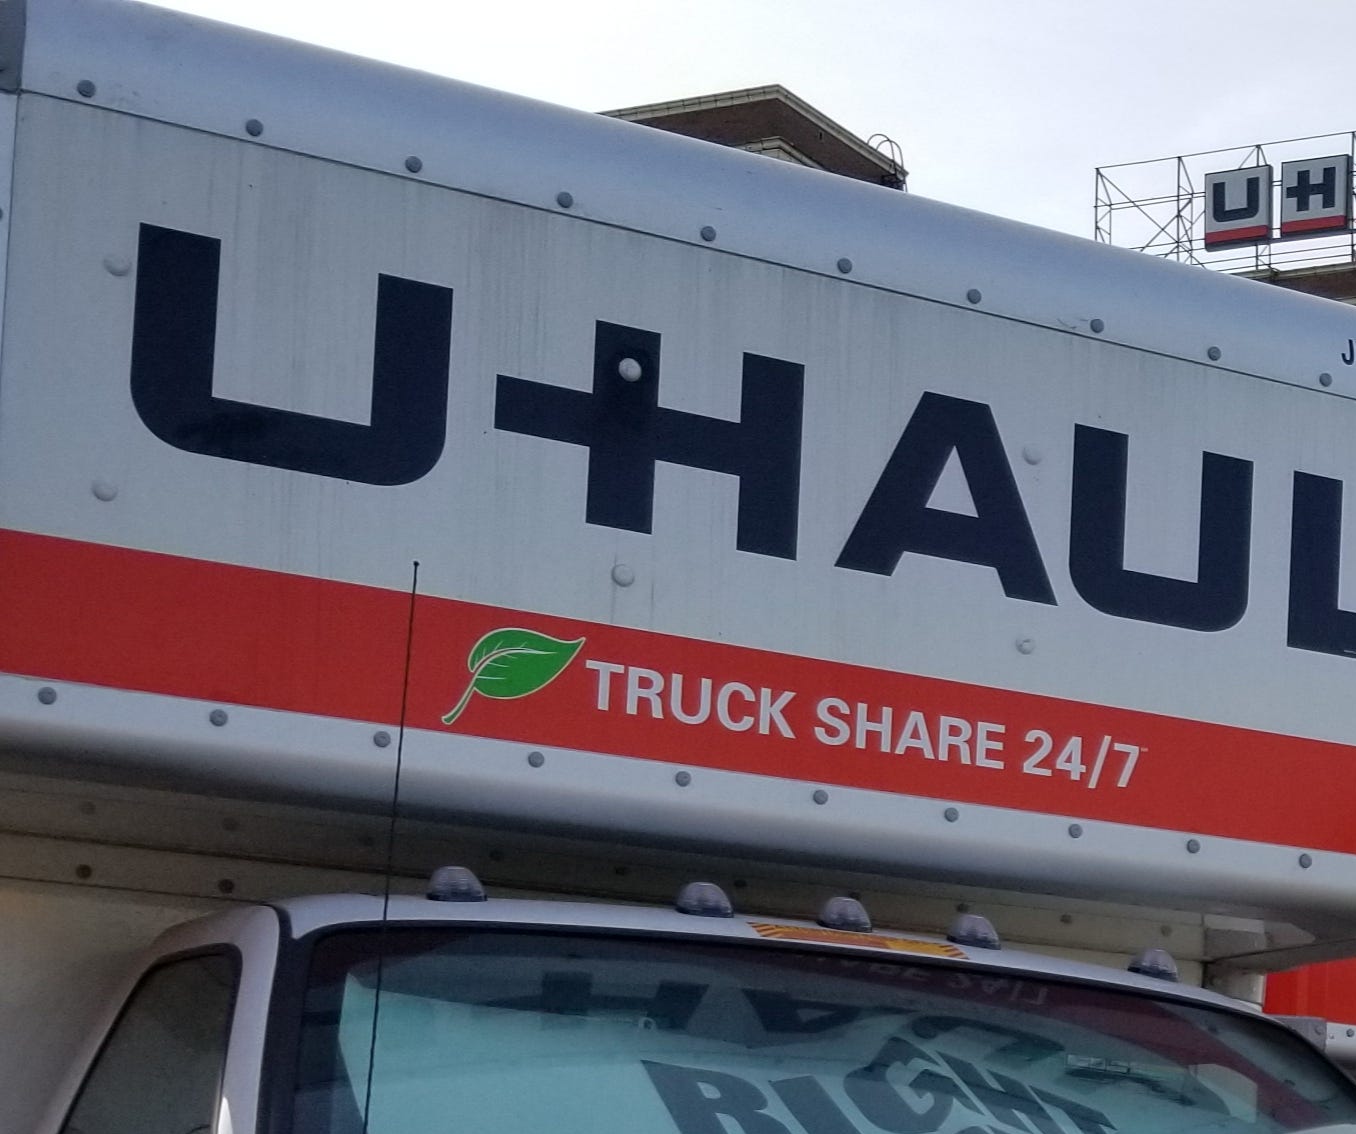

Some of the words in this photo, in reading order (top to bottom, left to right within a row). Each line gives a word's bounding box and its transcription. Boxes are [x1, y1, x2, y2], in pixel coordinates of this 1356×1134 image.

[585, 660, 796, 739] TRUCK
[814, 697, 1006, 770] SHARE
[1023, 729, 1140, 788] 24/7
